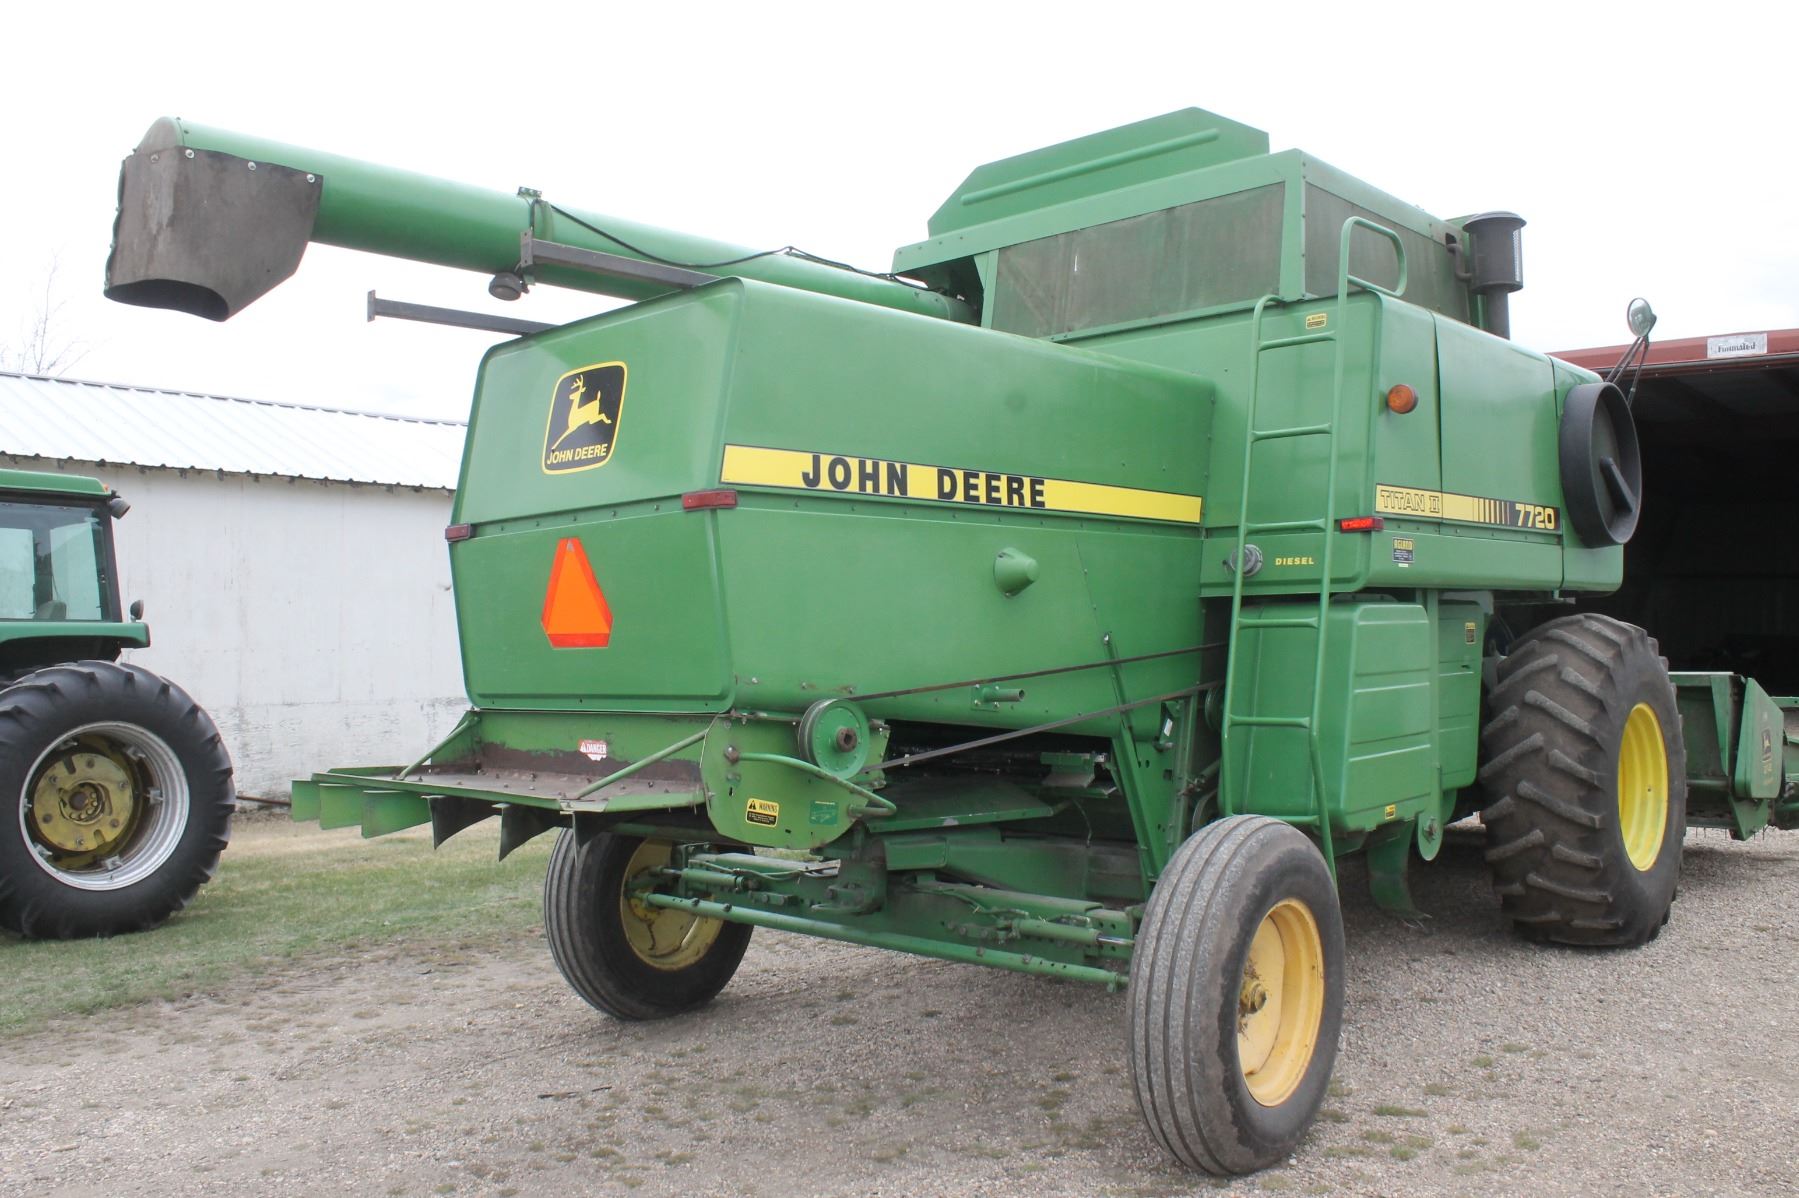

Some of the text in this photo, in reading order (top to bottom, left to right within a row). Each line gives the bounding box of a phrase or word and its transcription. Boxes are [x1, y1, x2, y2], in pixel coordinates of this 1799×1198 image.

[547, 443, 608, 465] JOHN DEERE
[801, 454, 1046, 508] JOHN DEERE
[1380, 489, 1441, 514] TITAN II
[1515, 503, 1555, 530] 7720
[1275, 557, 1314, 566] DIESEL
[586, 743, 607, 754] DANGER
